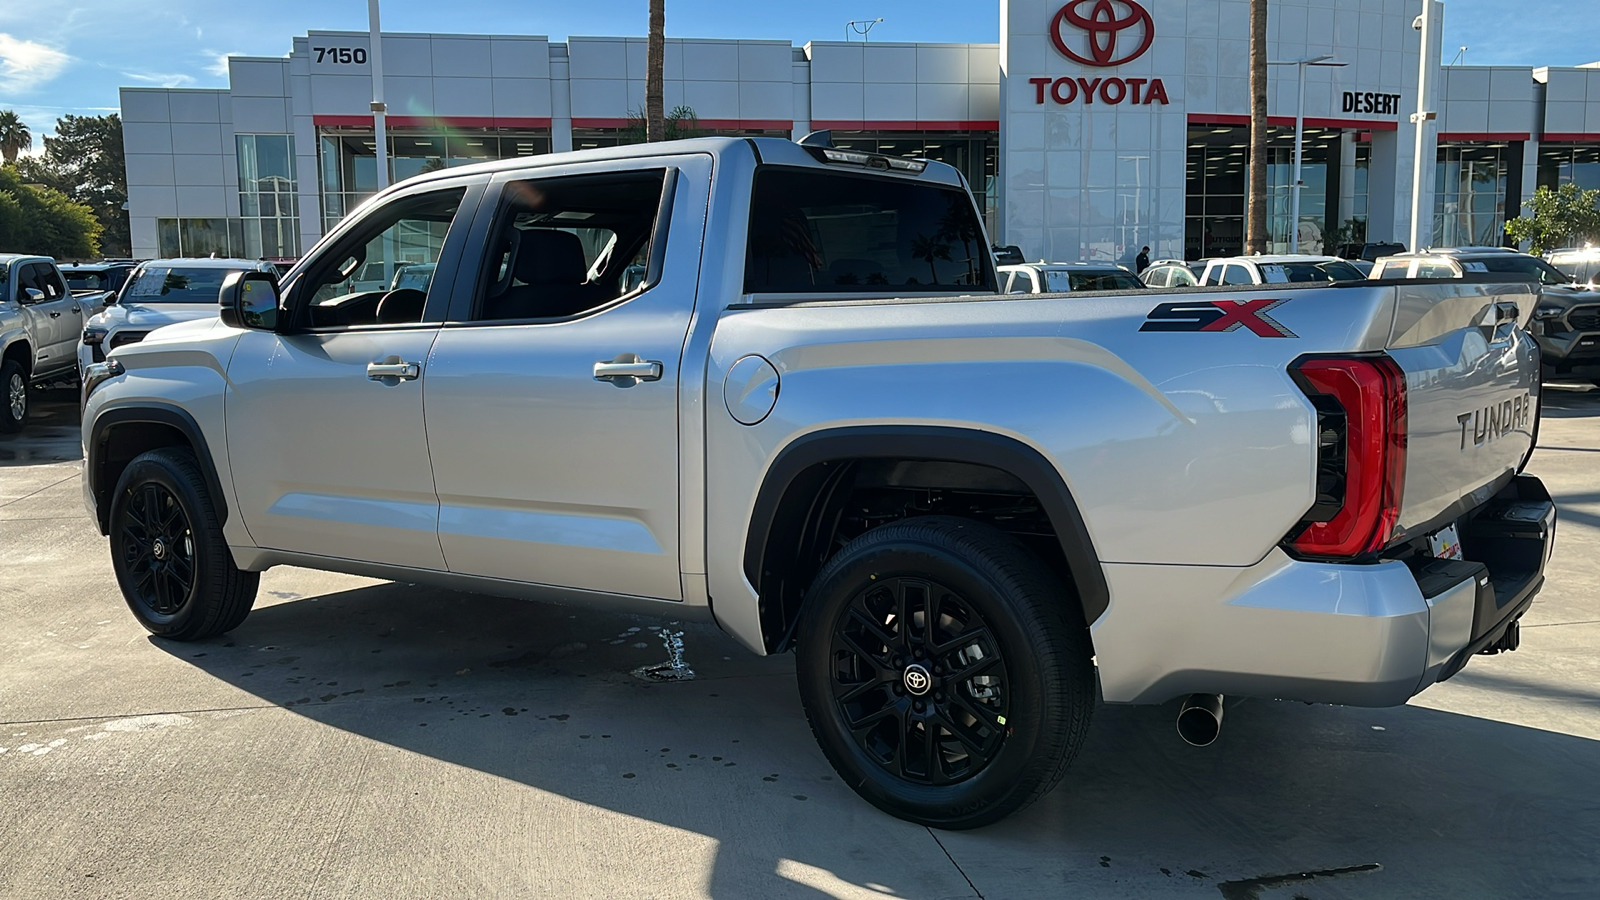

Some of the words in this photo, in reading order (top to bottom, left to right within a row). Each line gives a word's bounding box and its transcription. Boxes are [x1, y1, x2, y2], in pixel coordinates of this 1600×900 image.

[313, 47, 367, 64] 7150
[1029, 77, 1170, 105] TOYOTA
[1342, 91, 1401, 115] DESERT
[1212, 236, 1242, 244] UTIQUE
[1138, 298, 1300, 338] SX
[1456, 392, 1530, 451] TUNDRA
